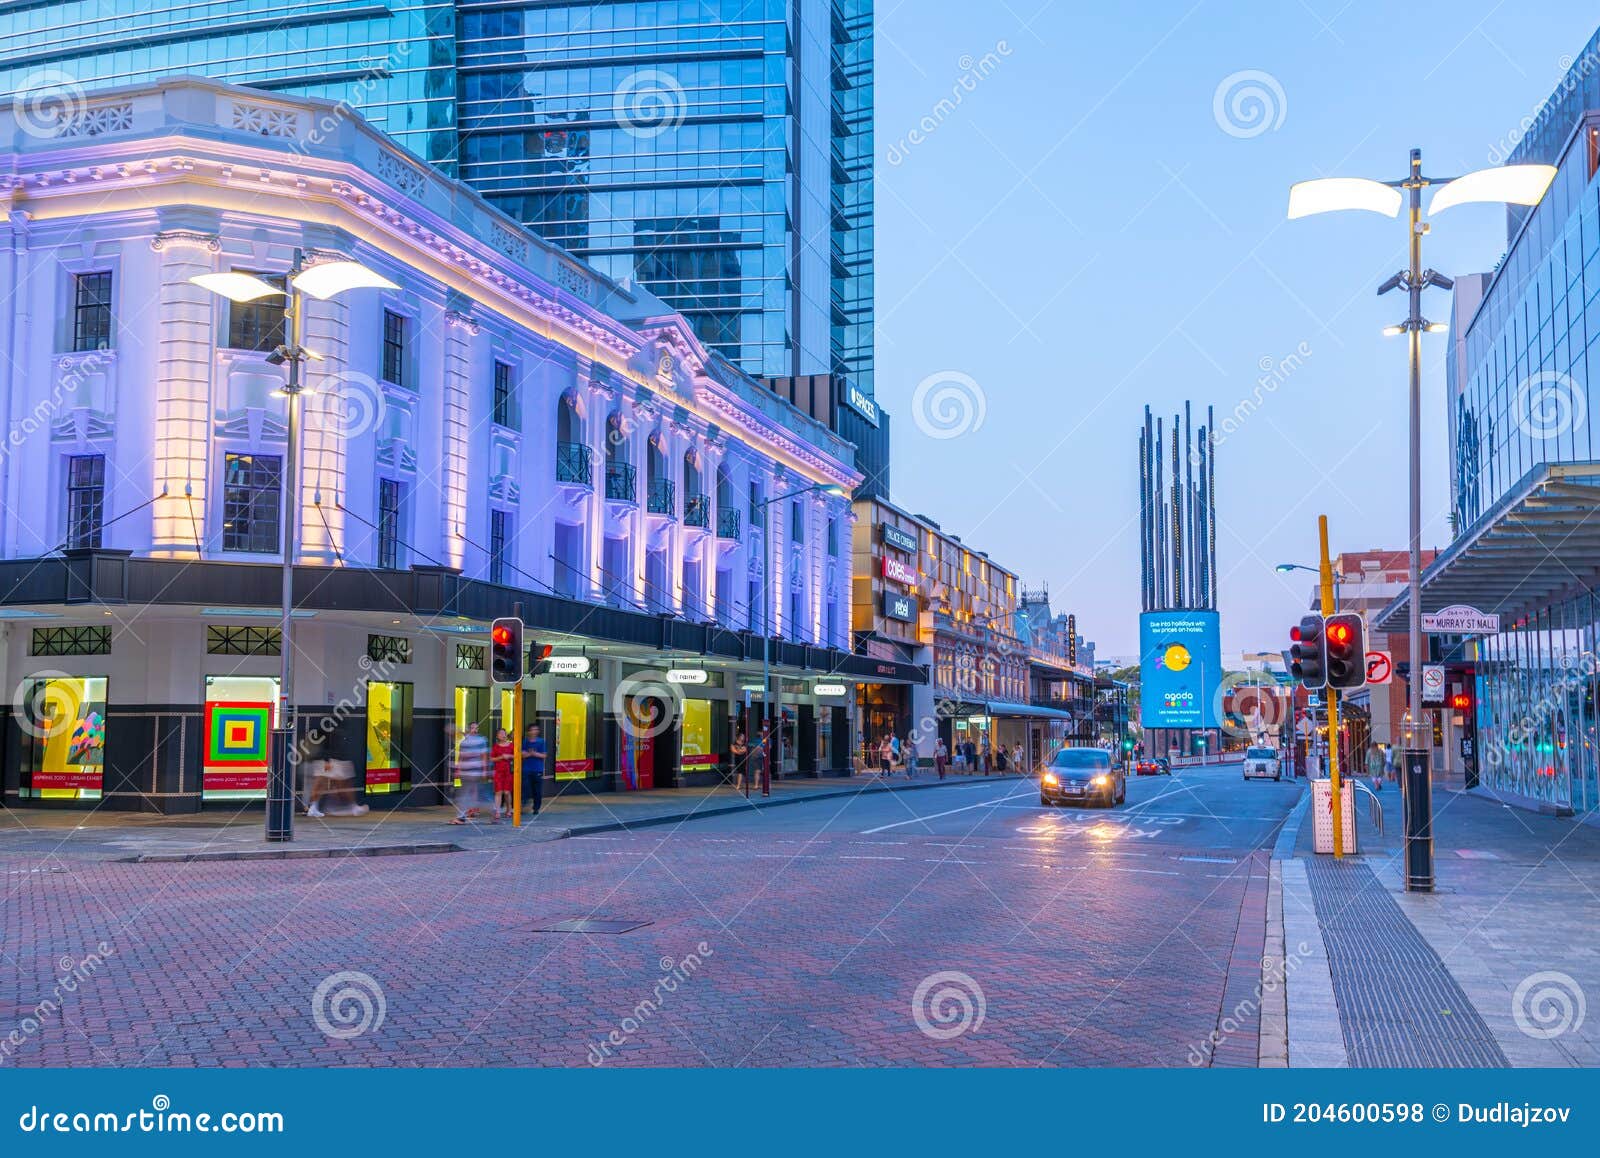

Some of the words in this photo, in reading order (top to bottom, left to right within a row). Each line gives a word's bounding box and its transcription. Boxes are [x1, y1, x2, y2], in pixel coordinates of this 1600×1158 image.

[856, 391, 875, 419] SPACES
[887, 559, 905, 581] coles
[895, 599, 908, 618] rebel
[1436, 619, 1466, 629] MURRAY
[1467, 619, 1475, 629] ST
[1477, 619, 1495, 629] MALL
[1164, 691, 1194, 702] agoda
